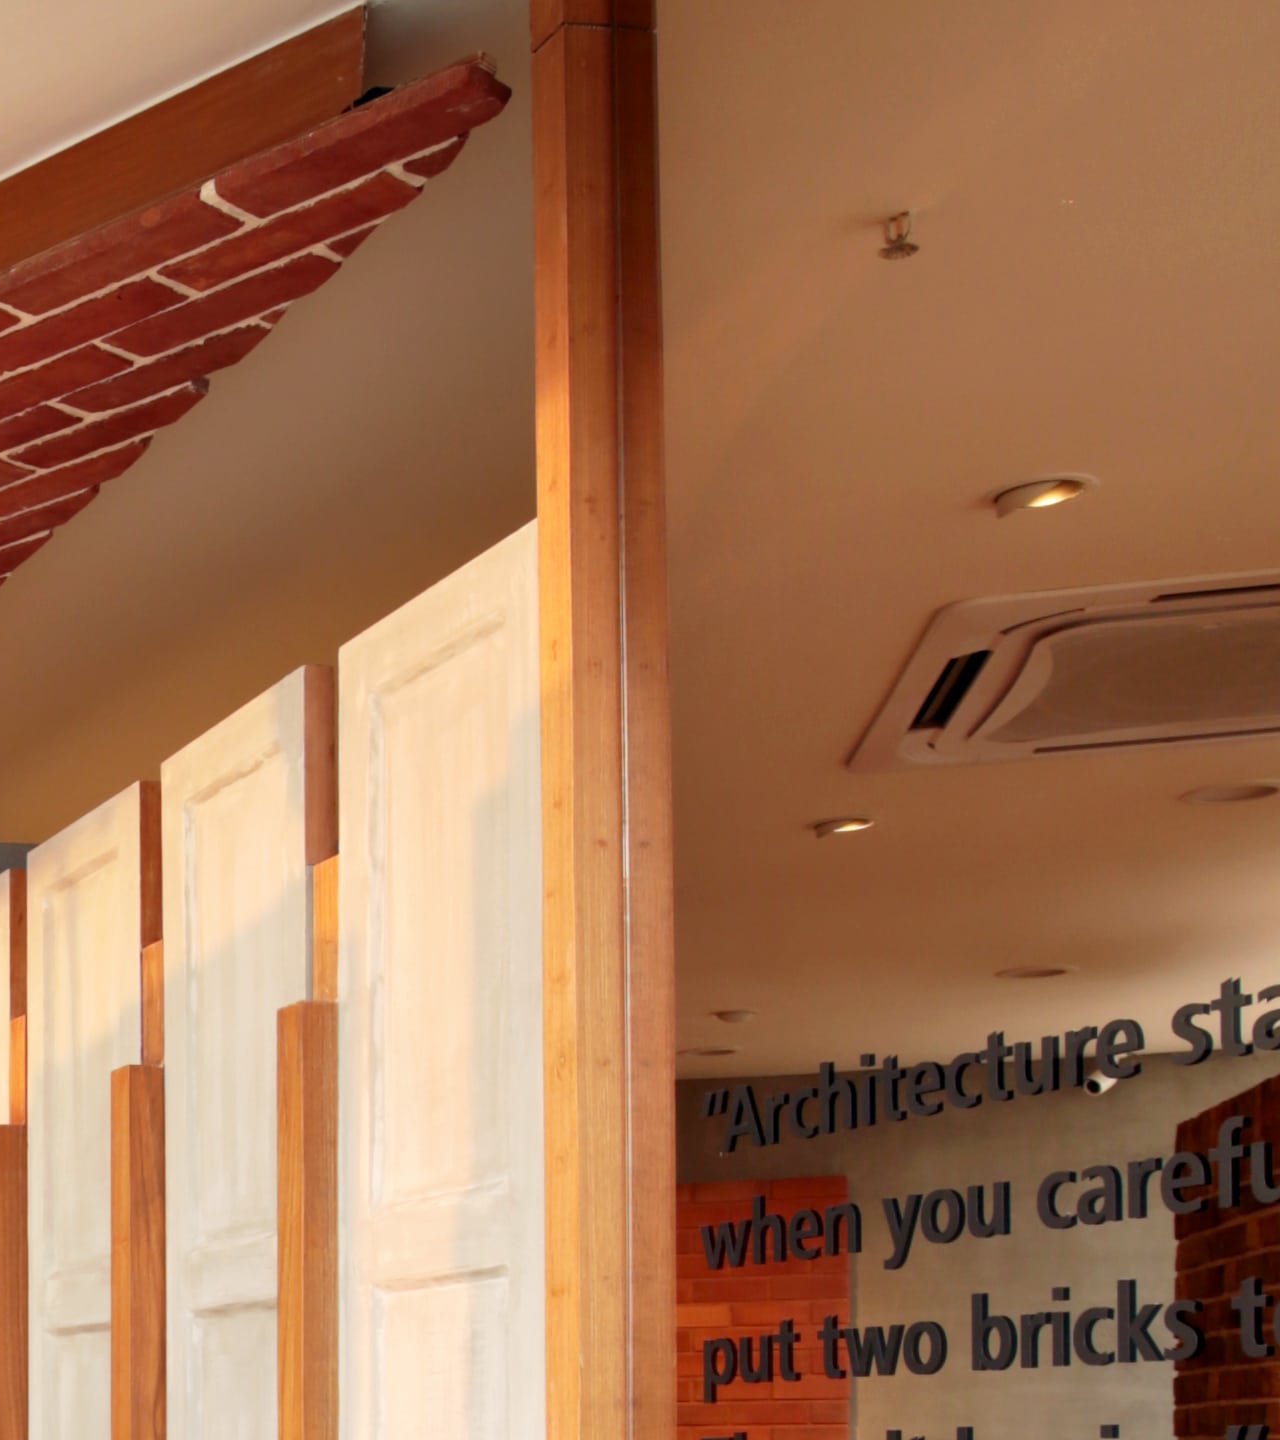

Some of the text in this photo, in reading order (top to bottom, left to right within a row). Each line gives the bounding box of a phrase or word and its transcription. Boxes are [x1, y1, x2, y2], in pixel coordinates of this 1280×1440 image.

[704, 1017, 1146, 1154] "Architecture
[701, 1194, 862, 1270] when
[882, 1180, 1011, 1270] you
[704, 1275, 1280, 1403] put two bricks t
